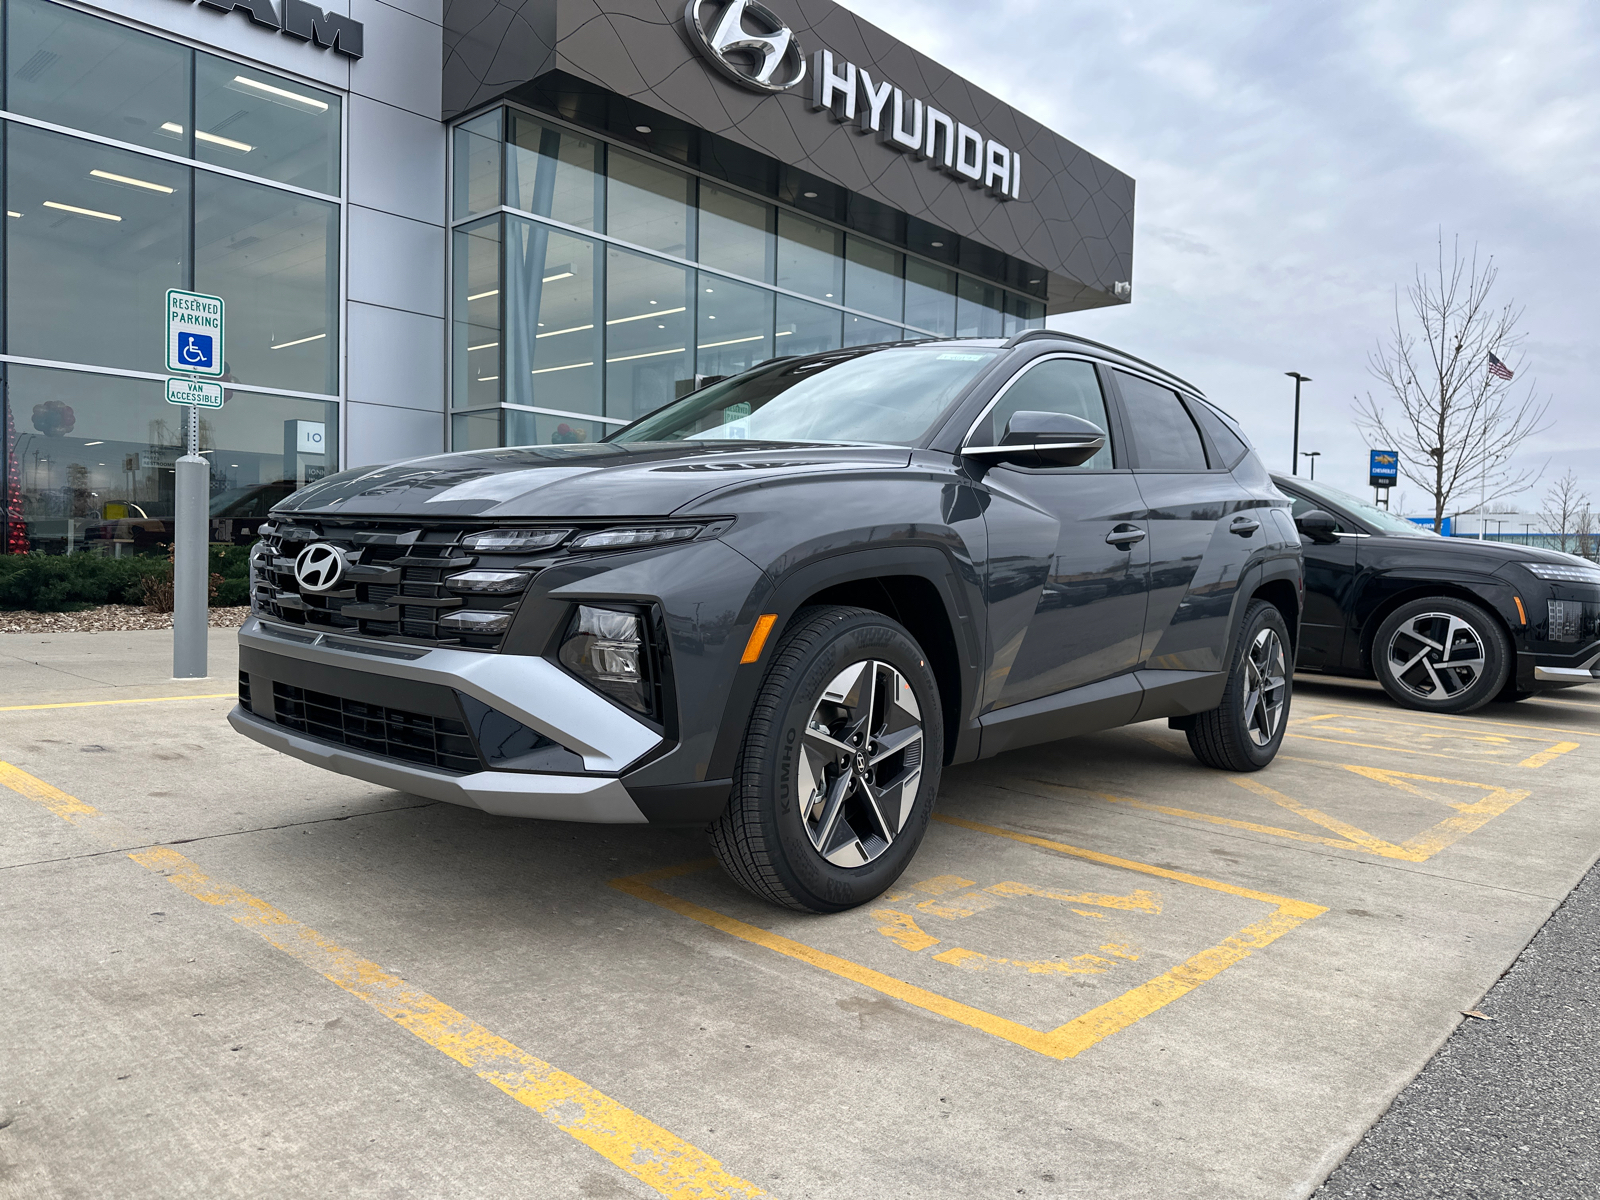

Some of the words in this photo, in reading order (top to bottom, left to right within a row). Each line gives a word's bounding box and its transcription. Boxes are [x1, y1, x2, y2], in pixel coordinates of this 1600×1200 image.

[814, 48, 1021, 200] HYUNDAI
[172, 297, 218, 315] RESERVED
[172, 311, 219, 329] PARKING
[188, 383, 203, 393] VAN
[170, 391, 219, 404] ACCESSIBLE
[780, 727, 797, 816] KUMHO
